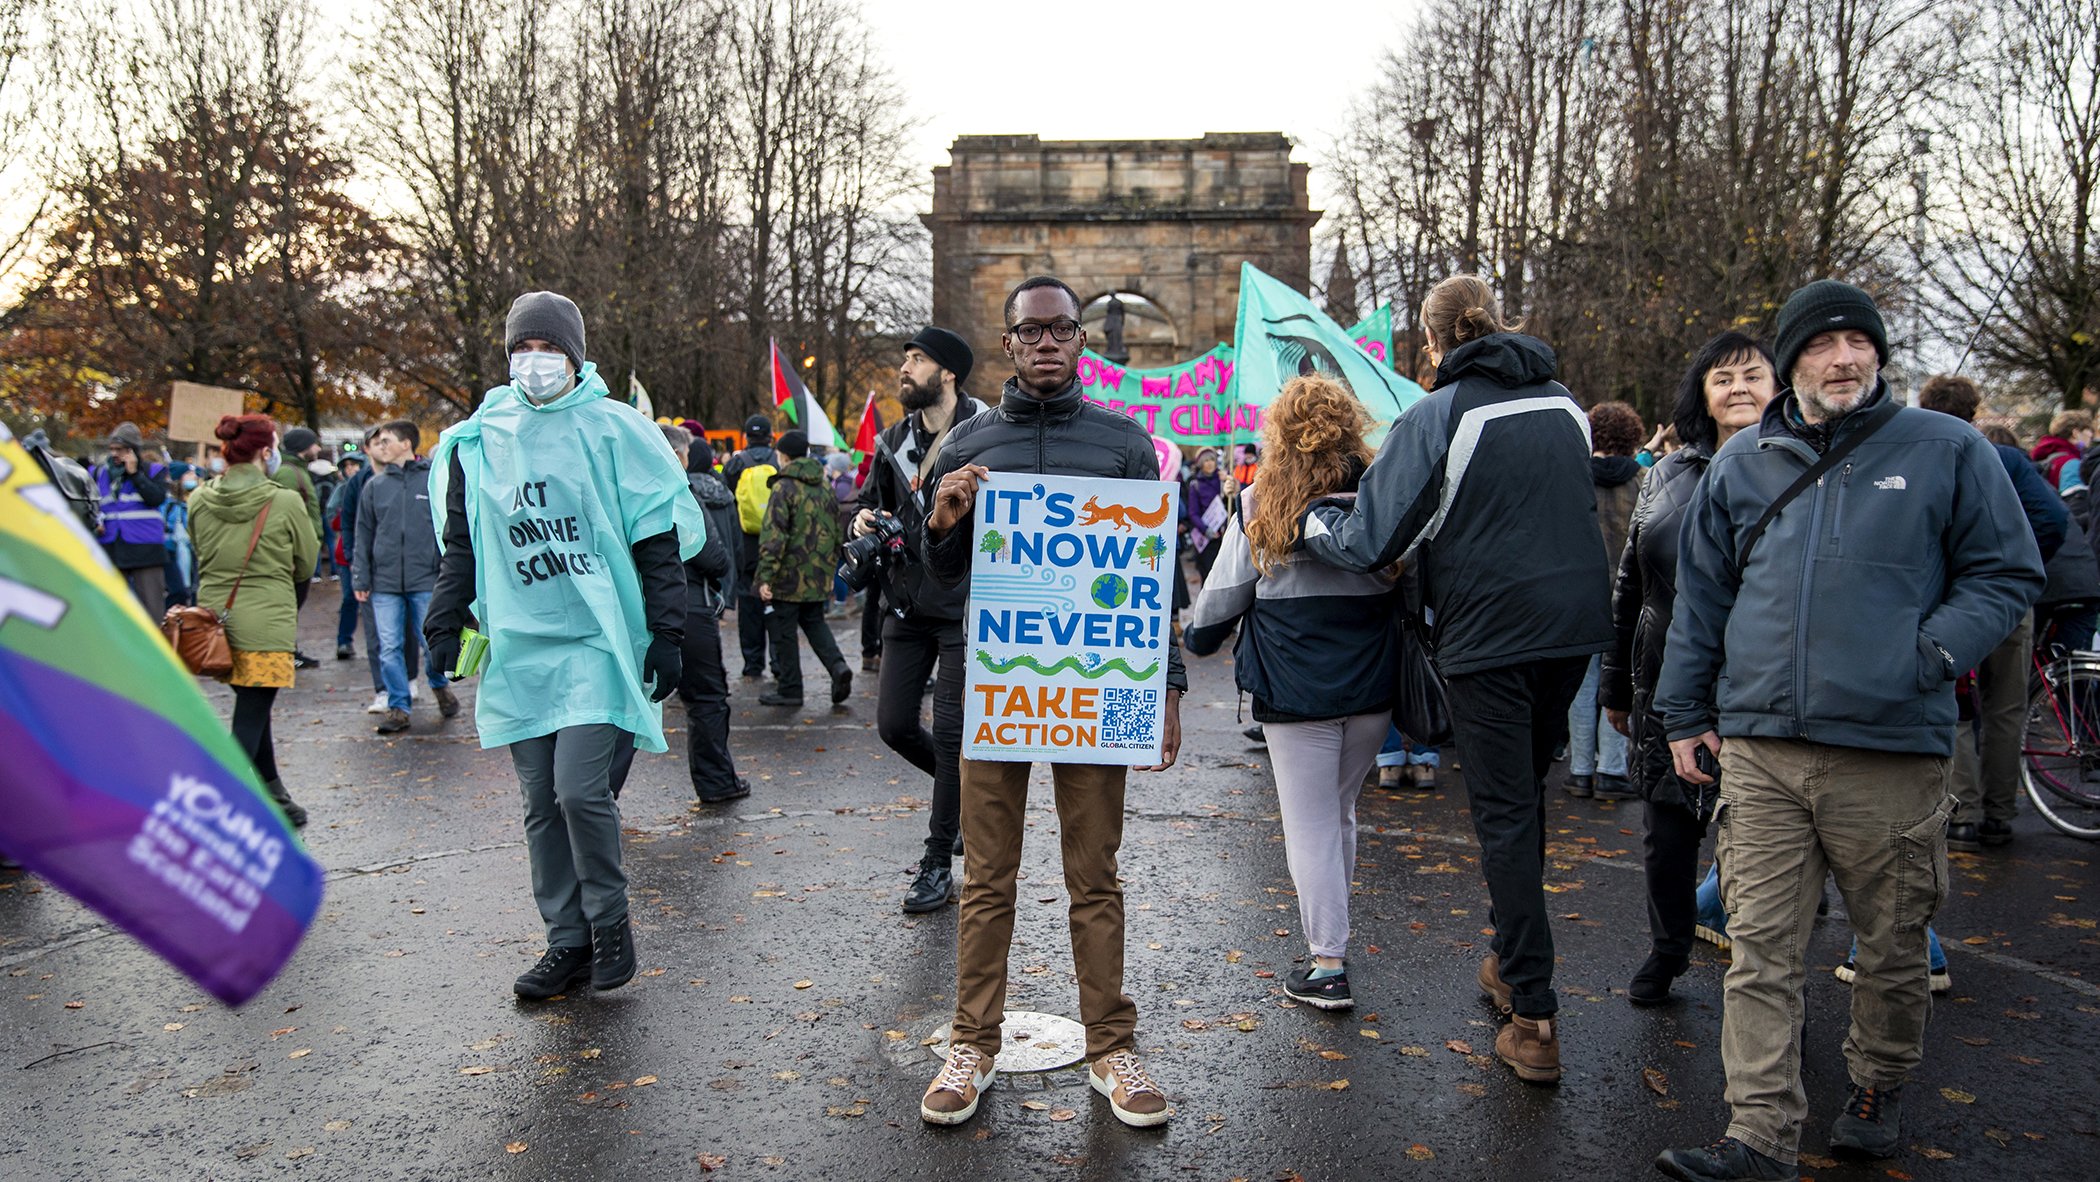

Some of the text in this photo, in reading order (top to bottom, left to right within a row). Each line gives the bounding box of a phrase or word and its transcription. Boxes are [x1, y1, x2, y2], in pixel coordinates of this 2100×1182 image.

[1077, 356, 1126, 391] OW
[1141, 355, 1235, 399] MANY
[513, 481, 547, 511] ACT
[985, 483, 1075, 528] IT'S
[509, 516, 580, 548] ON THE
[1011, 531, 1138, 569] NOW
[516, 550, 595, 586] SCINCE
[978, 609, 1161, 649] NEVER!
[974, 684, 1099, 719] TAKE
[973, 722, 1097, 747] ACTION
[169, 773, 284, 869] YOUNG
